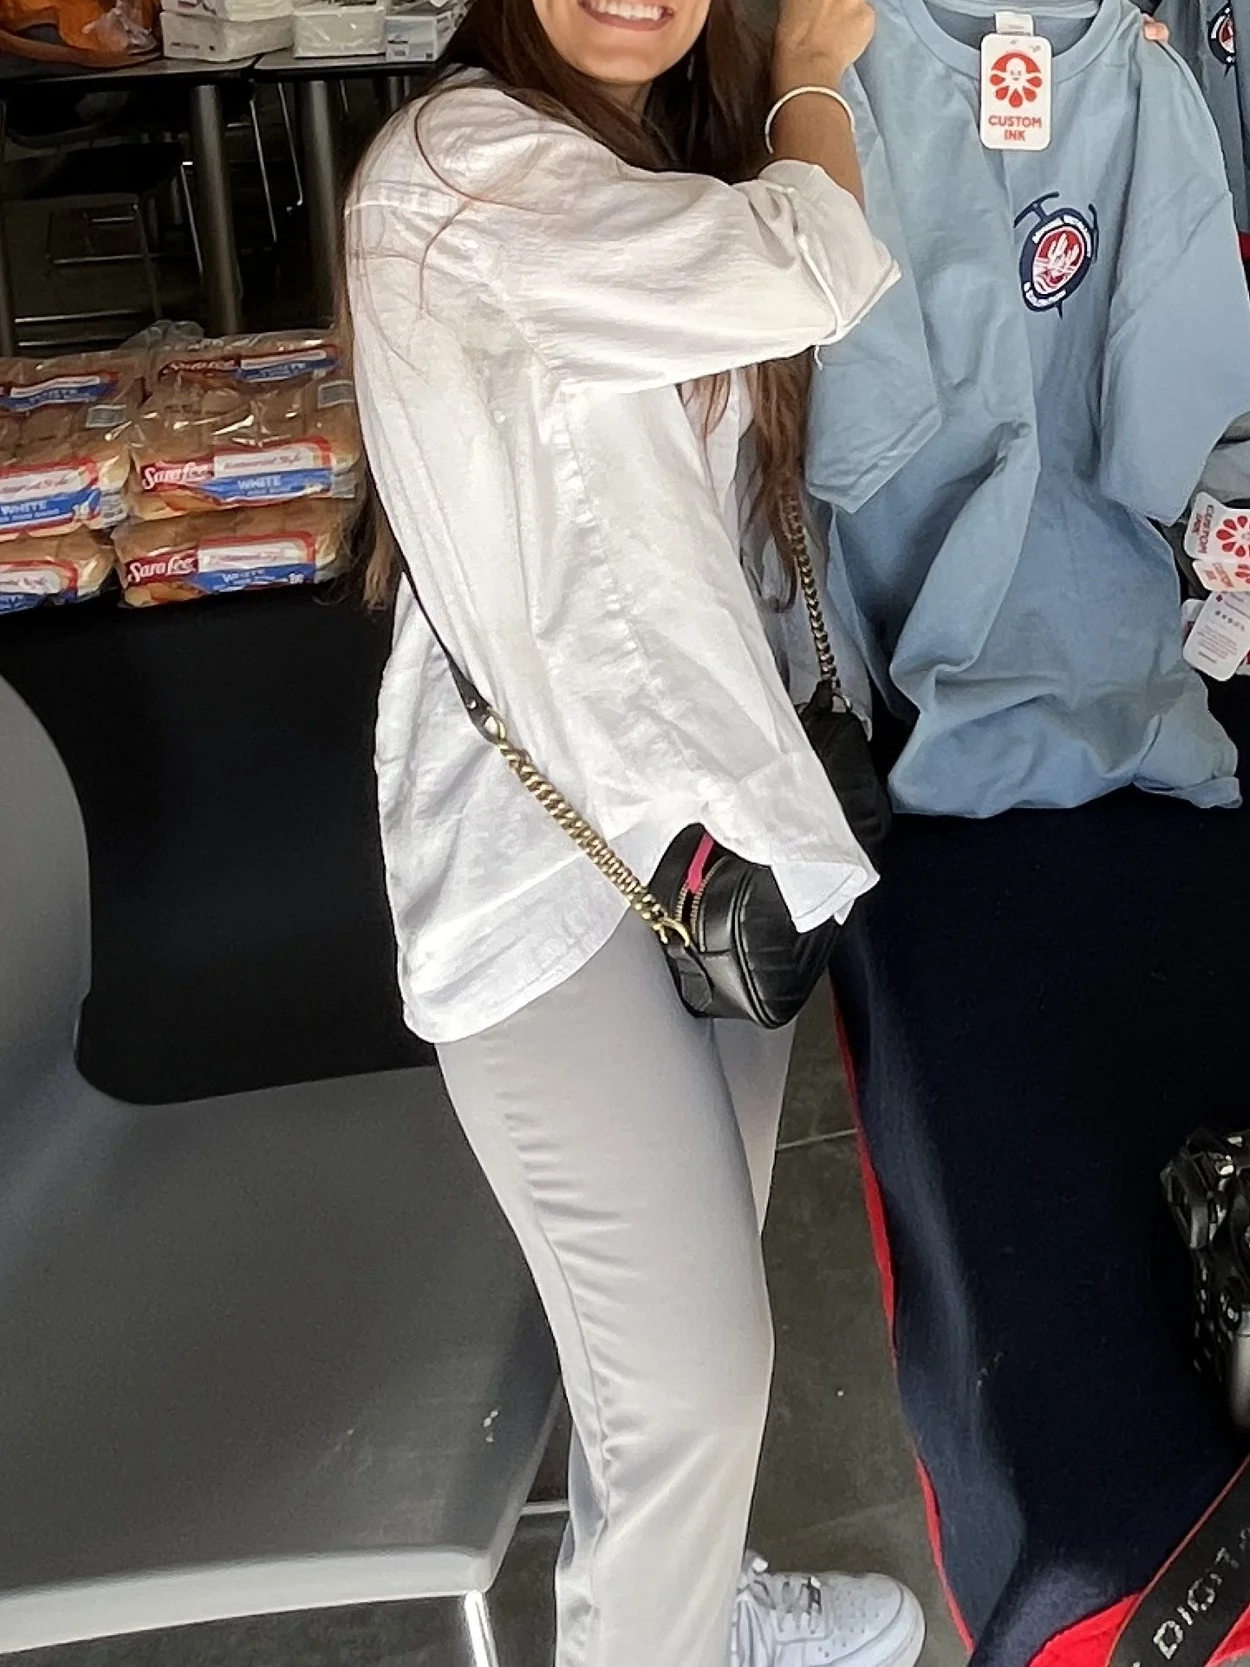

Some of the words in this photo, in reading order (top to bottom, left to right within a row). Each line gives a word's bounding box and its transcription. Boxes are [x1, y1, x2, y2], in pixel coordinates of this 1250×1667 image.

[987, 114, 1043, 128] CUSTOM
[1003, 129, 1026, 142] INK
[127, 562, 165, 585] Sara
[166, 555, 196, 576] Lee
